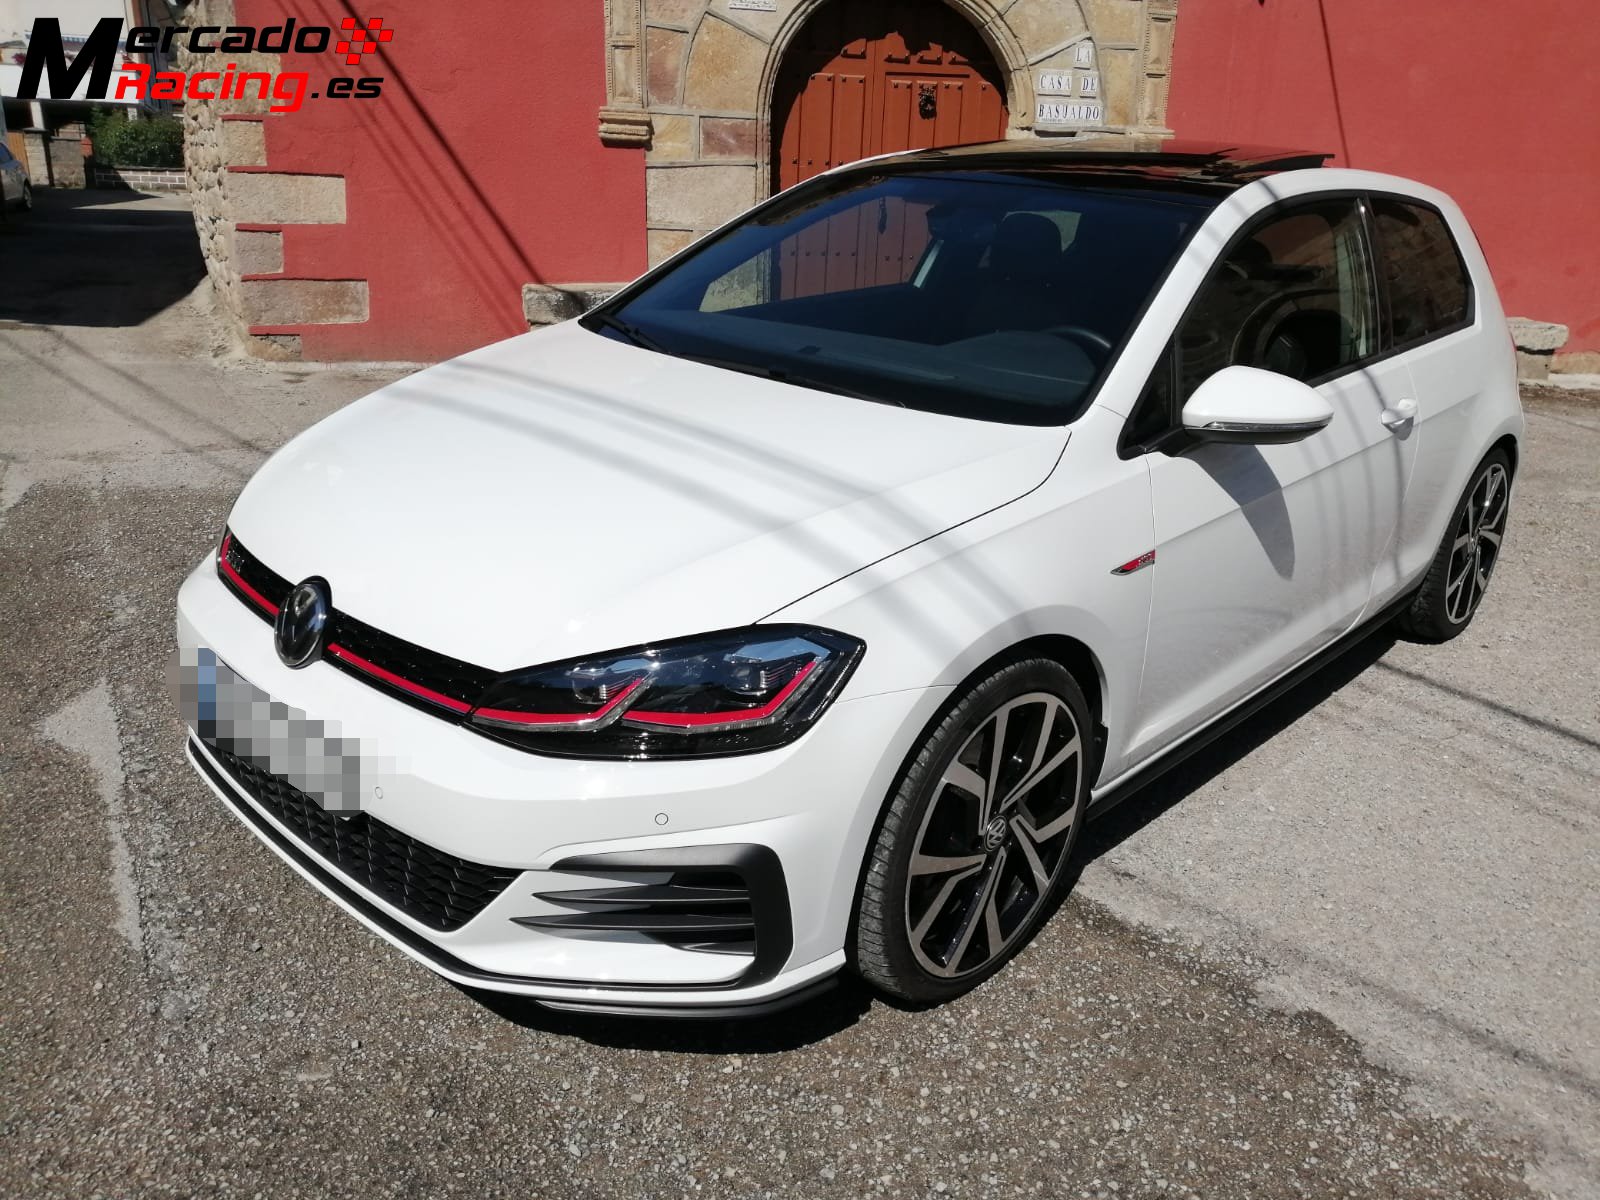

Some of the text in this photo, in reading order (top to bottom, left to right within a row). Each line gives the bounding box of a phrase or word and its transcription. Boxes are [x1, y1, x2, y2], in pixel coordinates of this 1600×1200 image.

[1076, 47, 1092, 62] LA
[1040, 74, 1098, 91] CASA DE
[1038, 104, 1100, 120] BASUALDO
